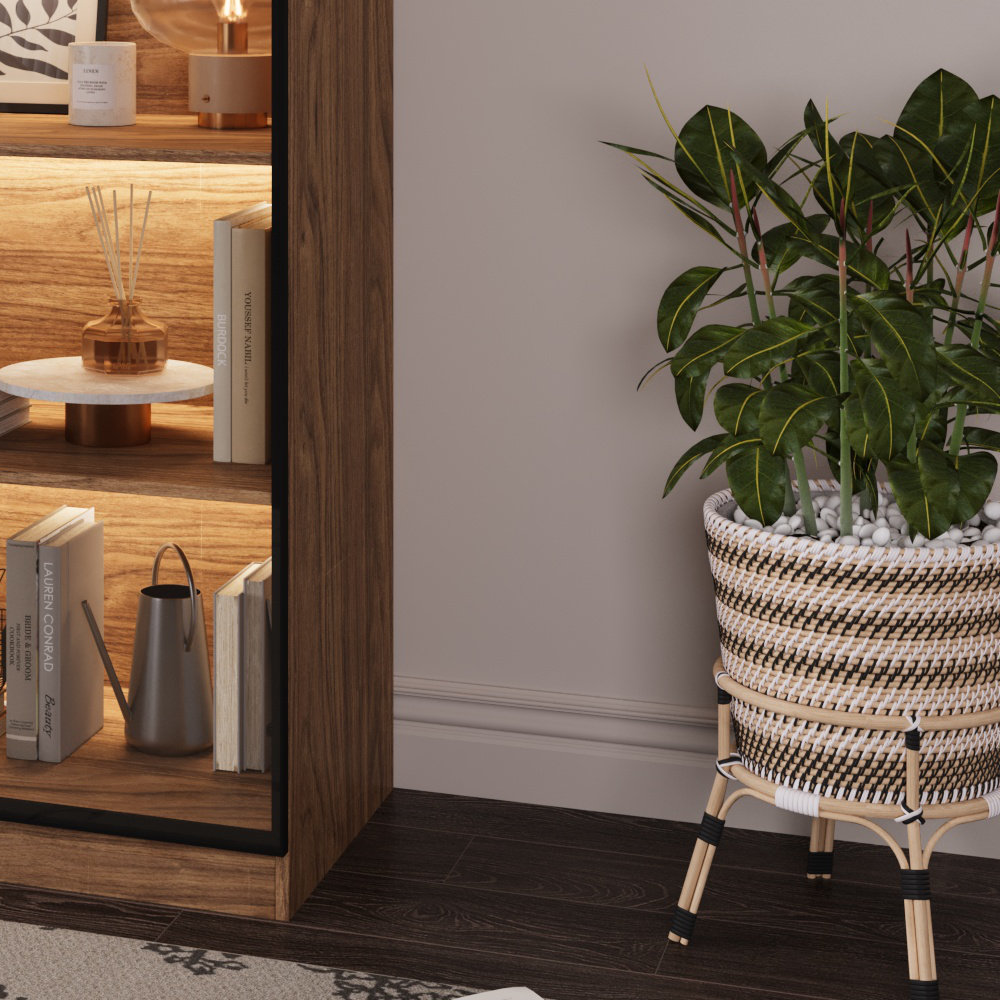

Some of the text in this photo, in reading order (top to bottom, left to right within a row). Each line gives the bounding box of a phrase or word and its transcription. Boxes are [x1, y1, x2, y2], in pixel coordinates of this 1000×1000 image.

[244, 291, 252, 335] YOUSSEF
[217, 313, 227, 367] BURDOCK
[244, 335, 252, 365] NABIL
[43, 562, 54, 672] LAUREN CONRAD
[24, 641, 31, 650] &
[43, 693, 56, 739] Beauty
